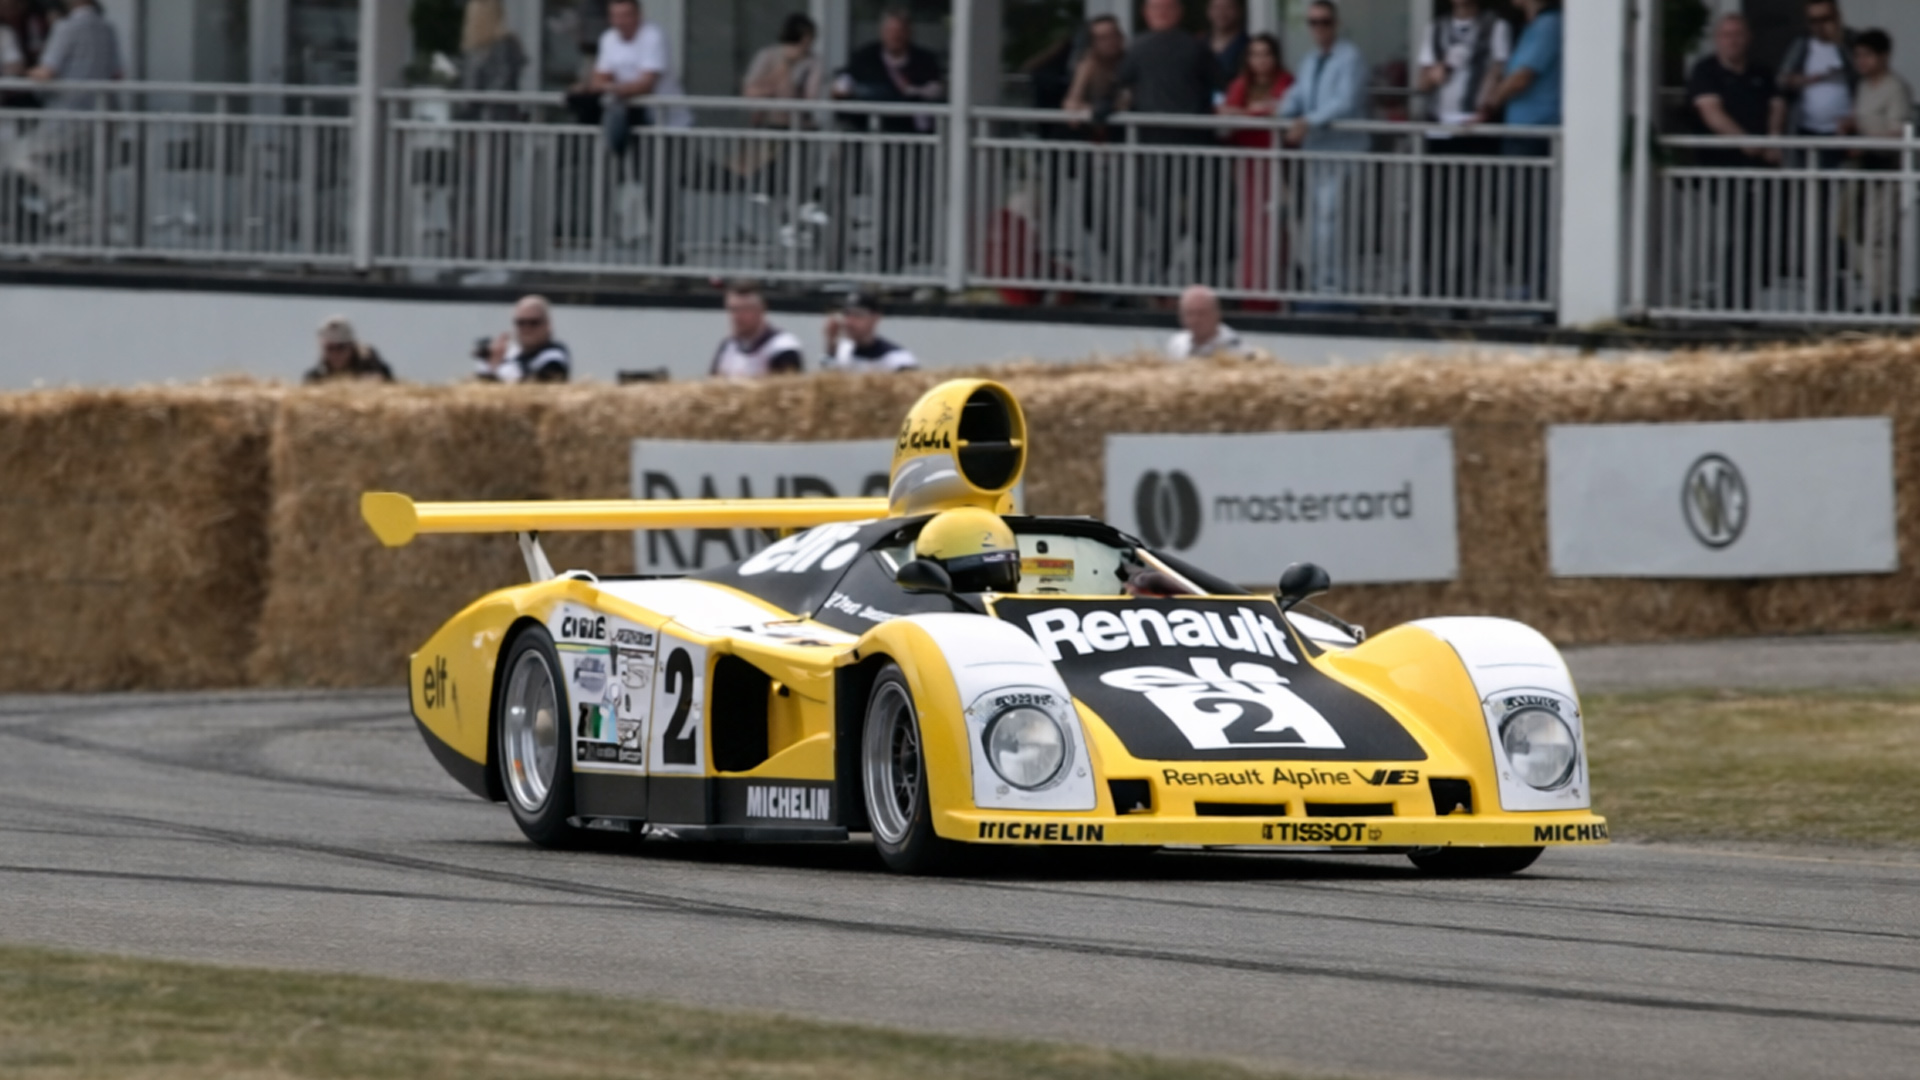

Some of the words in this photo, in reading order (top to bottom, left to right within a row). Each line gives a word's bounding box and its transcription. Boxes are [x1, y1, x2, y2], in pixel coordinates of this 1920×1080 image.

[1214, 481, 1413, 523] mastercard
[1027, 607, 1298, 662] Renault
[423, 655, 447, 709] elf
[663, 647, 696, 765] 2
[1194, 698, 1306, 744] 2
[1163, 769, 1264, 785] Renault
[1273, 768, 1350, 789] Alpine
[747, 786, 829, 820] MICHELIN
